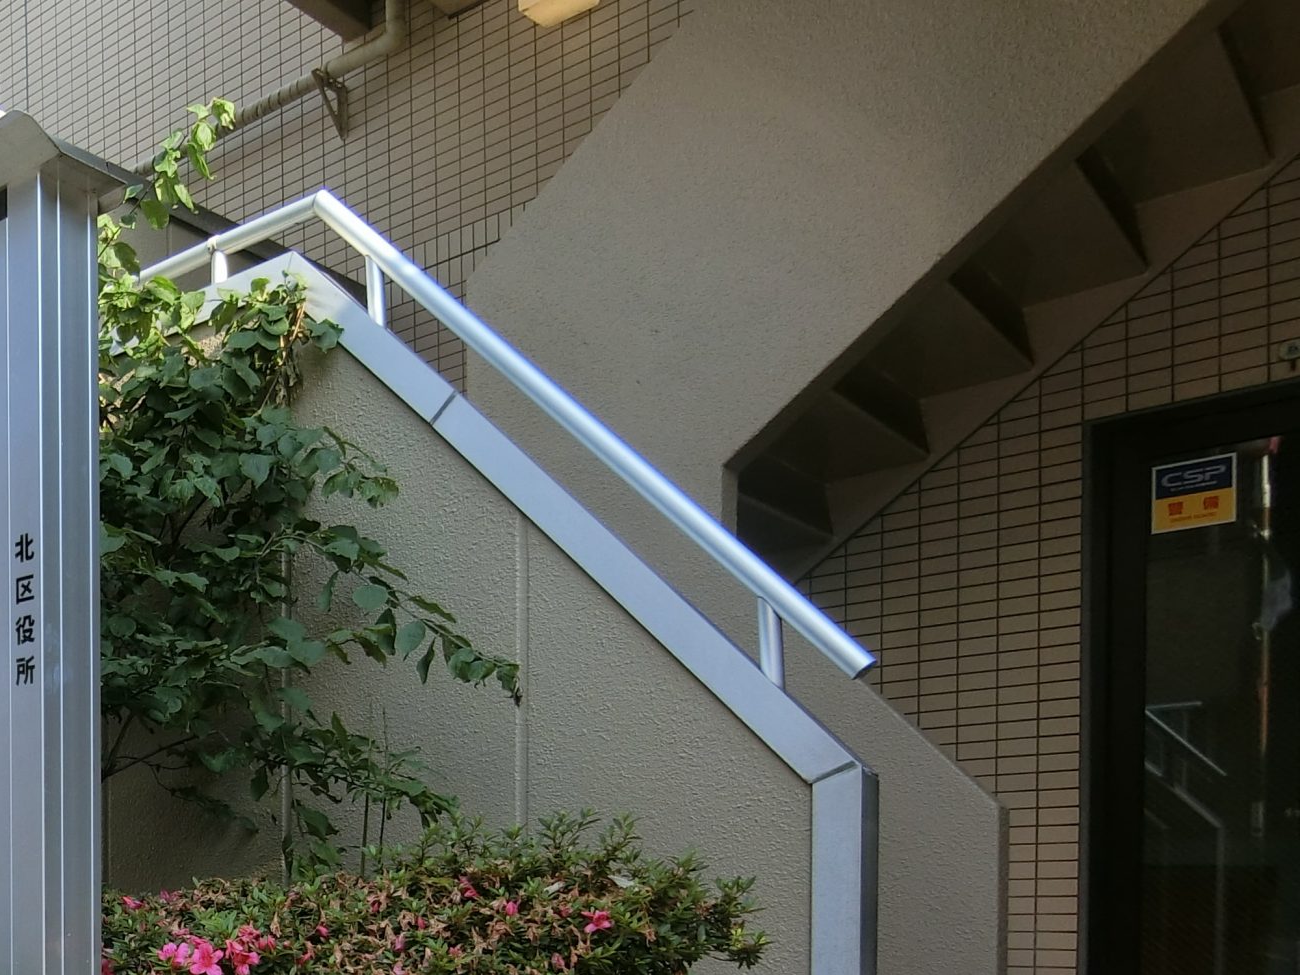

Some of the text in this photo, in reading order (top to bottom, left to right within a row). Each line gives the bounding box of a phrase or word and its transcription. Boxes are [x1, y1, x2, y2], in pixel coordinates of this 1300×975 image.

[1161, 465, 1226, 488] CSP
[15, 533, 36, 686] 北区役所
